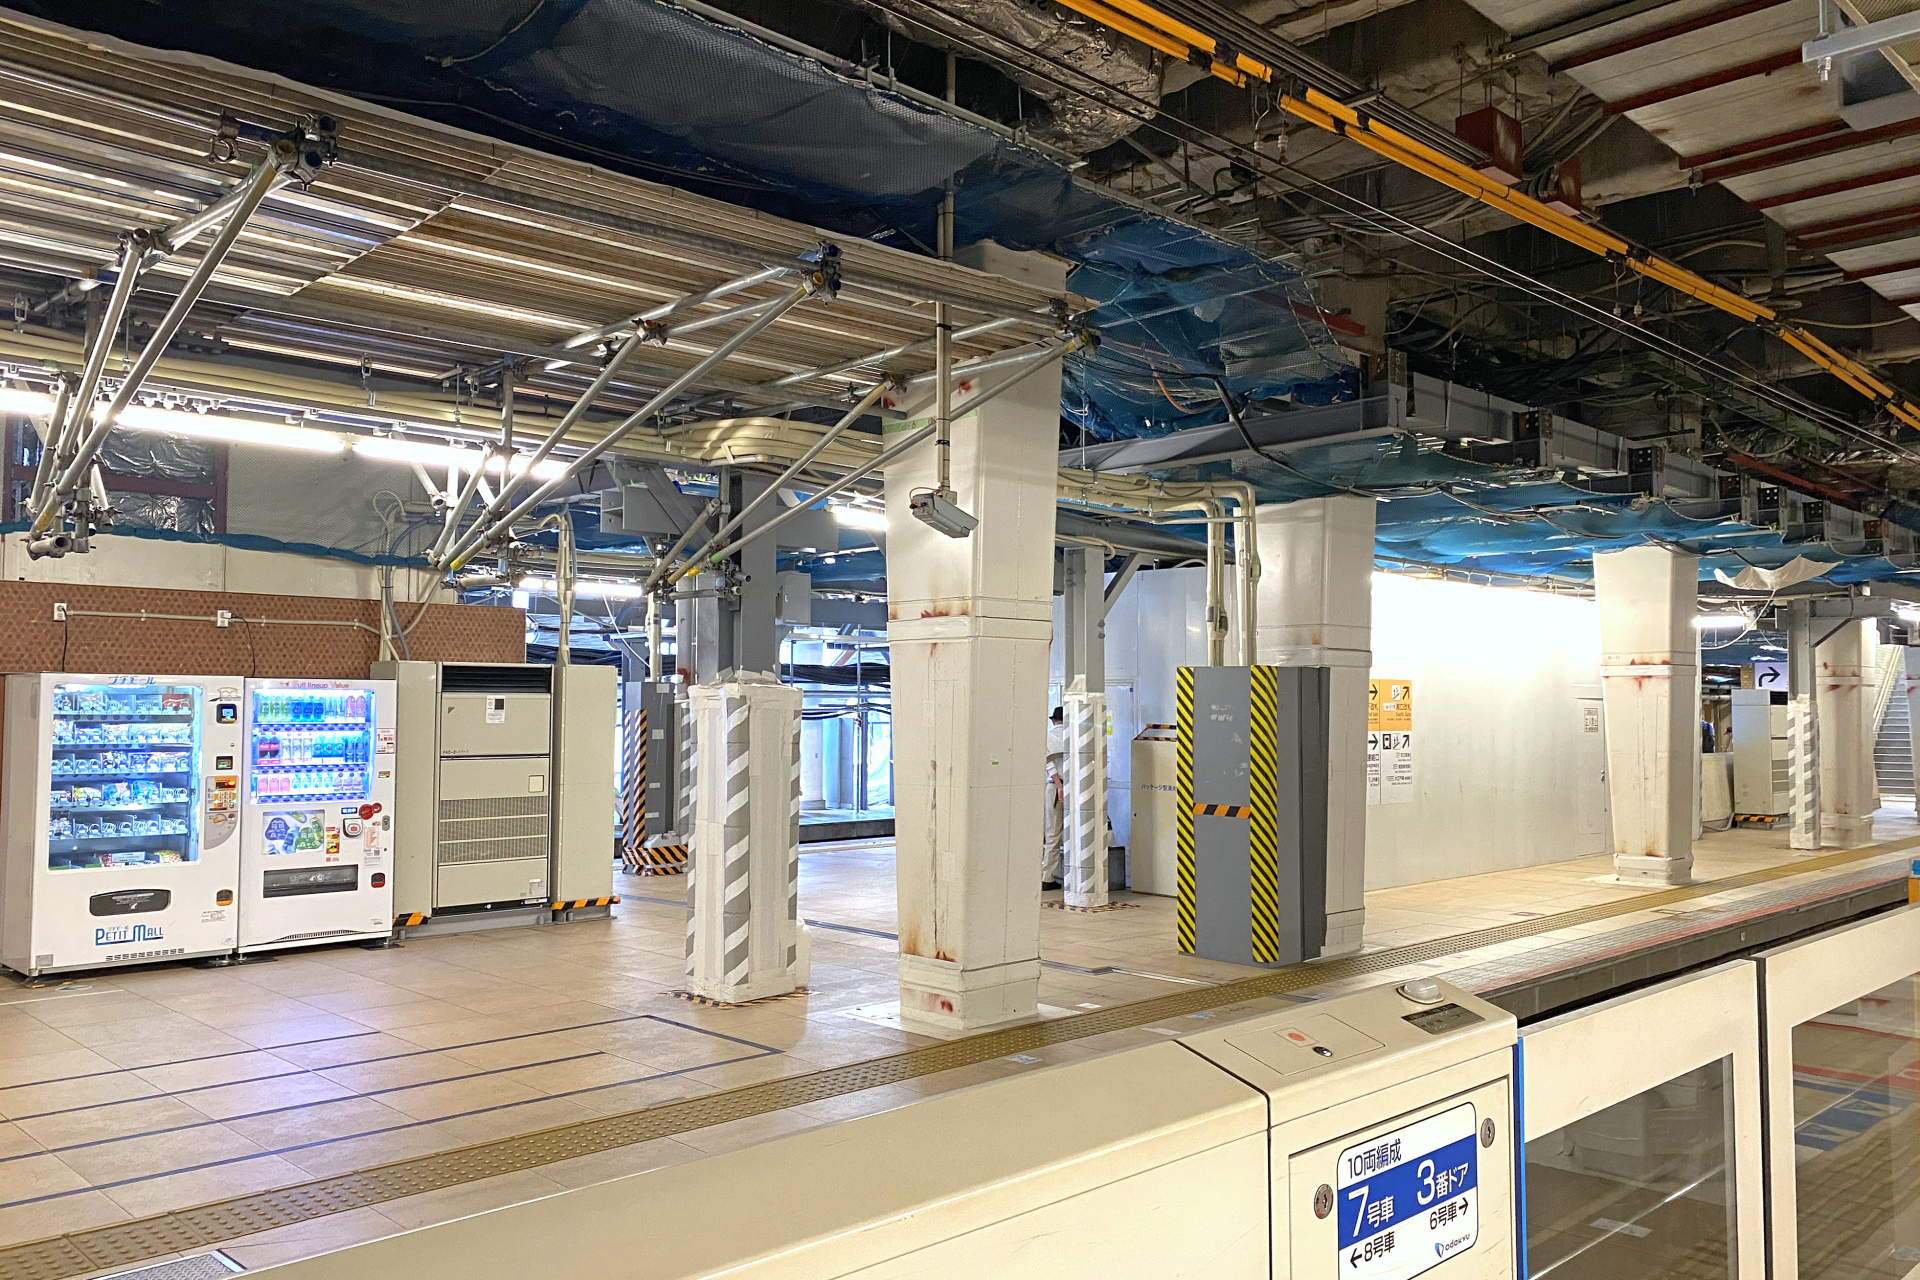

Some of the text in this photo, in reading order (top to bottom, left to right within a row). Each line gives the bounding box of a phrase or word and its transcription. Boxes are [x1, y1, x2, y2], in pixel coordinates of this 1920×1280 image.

[292, 680, 350, 689] Full lineup Value
[1348, 1138, 1402, 1179] 10両編成
[1417, 1159, 1469, 1206] 3番ドア
[1348, 1185, 1395, 1238] 7号車
[1430, 1201, 1458, 1230] 6号車
[1364, 1231, 1396, 1262] 8号車
